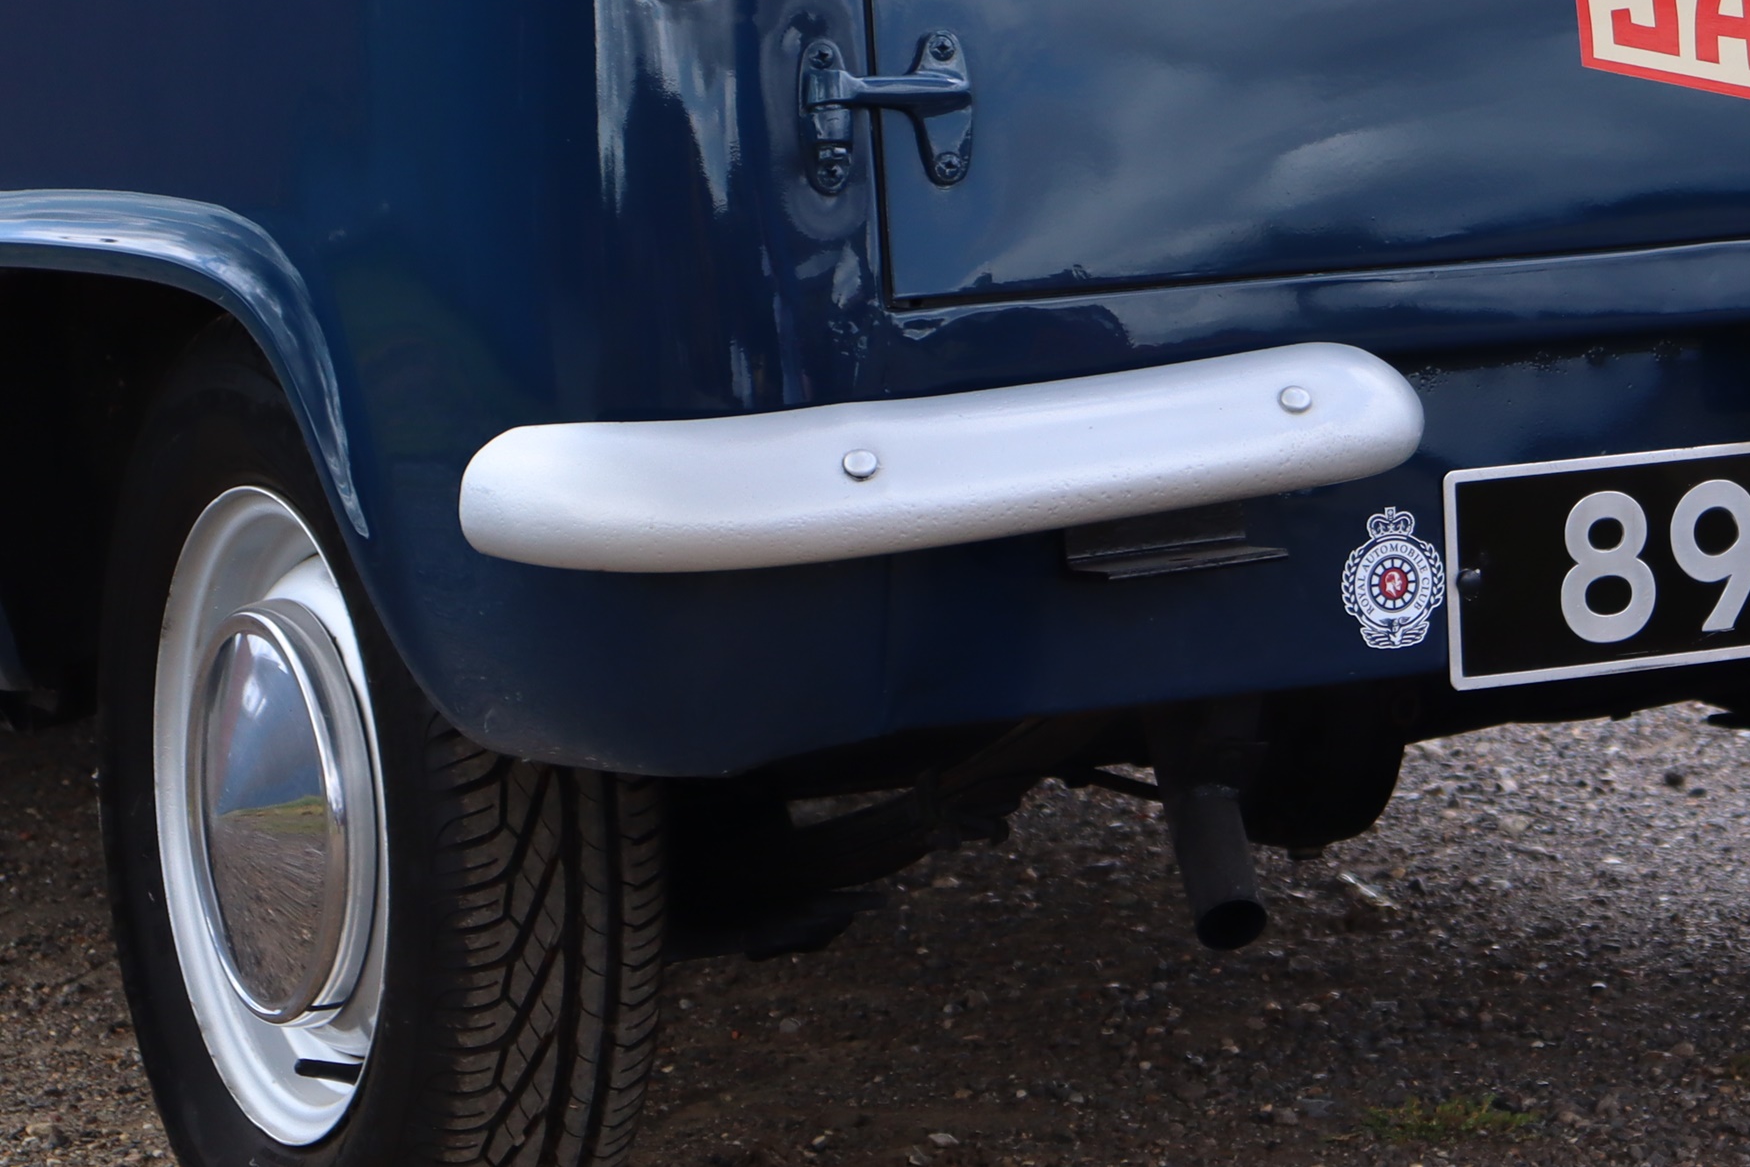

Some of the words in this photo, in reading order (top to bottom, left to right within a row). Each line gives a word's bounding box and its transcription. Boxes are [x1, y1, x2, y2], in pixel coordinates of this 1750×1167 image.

[1362, 543, 1428, 573] AUTOMOBILE
[1356, 575, 1375, 615] ROYAL
[1413, 577, 1430, 610] CLUB
